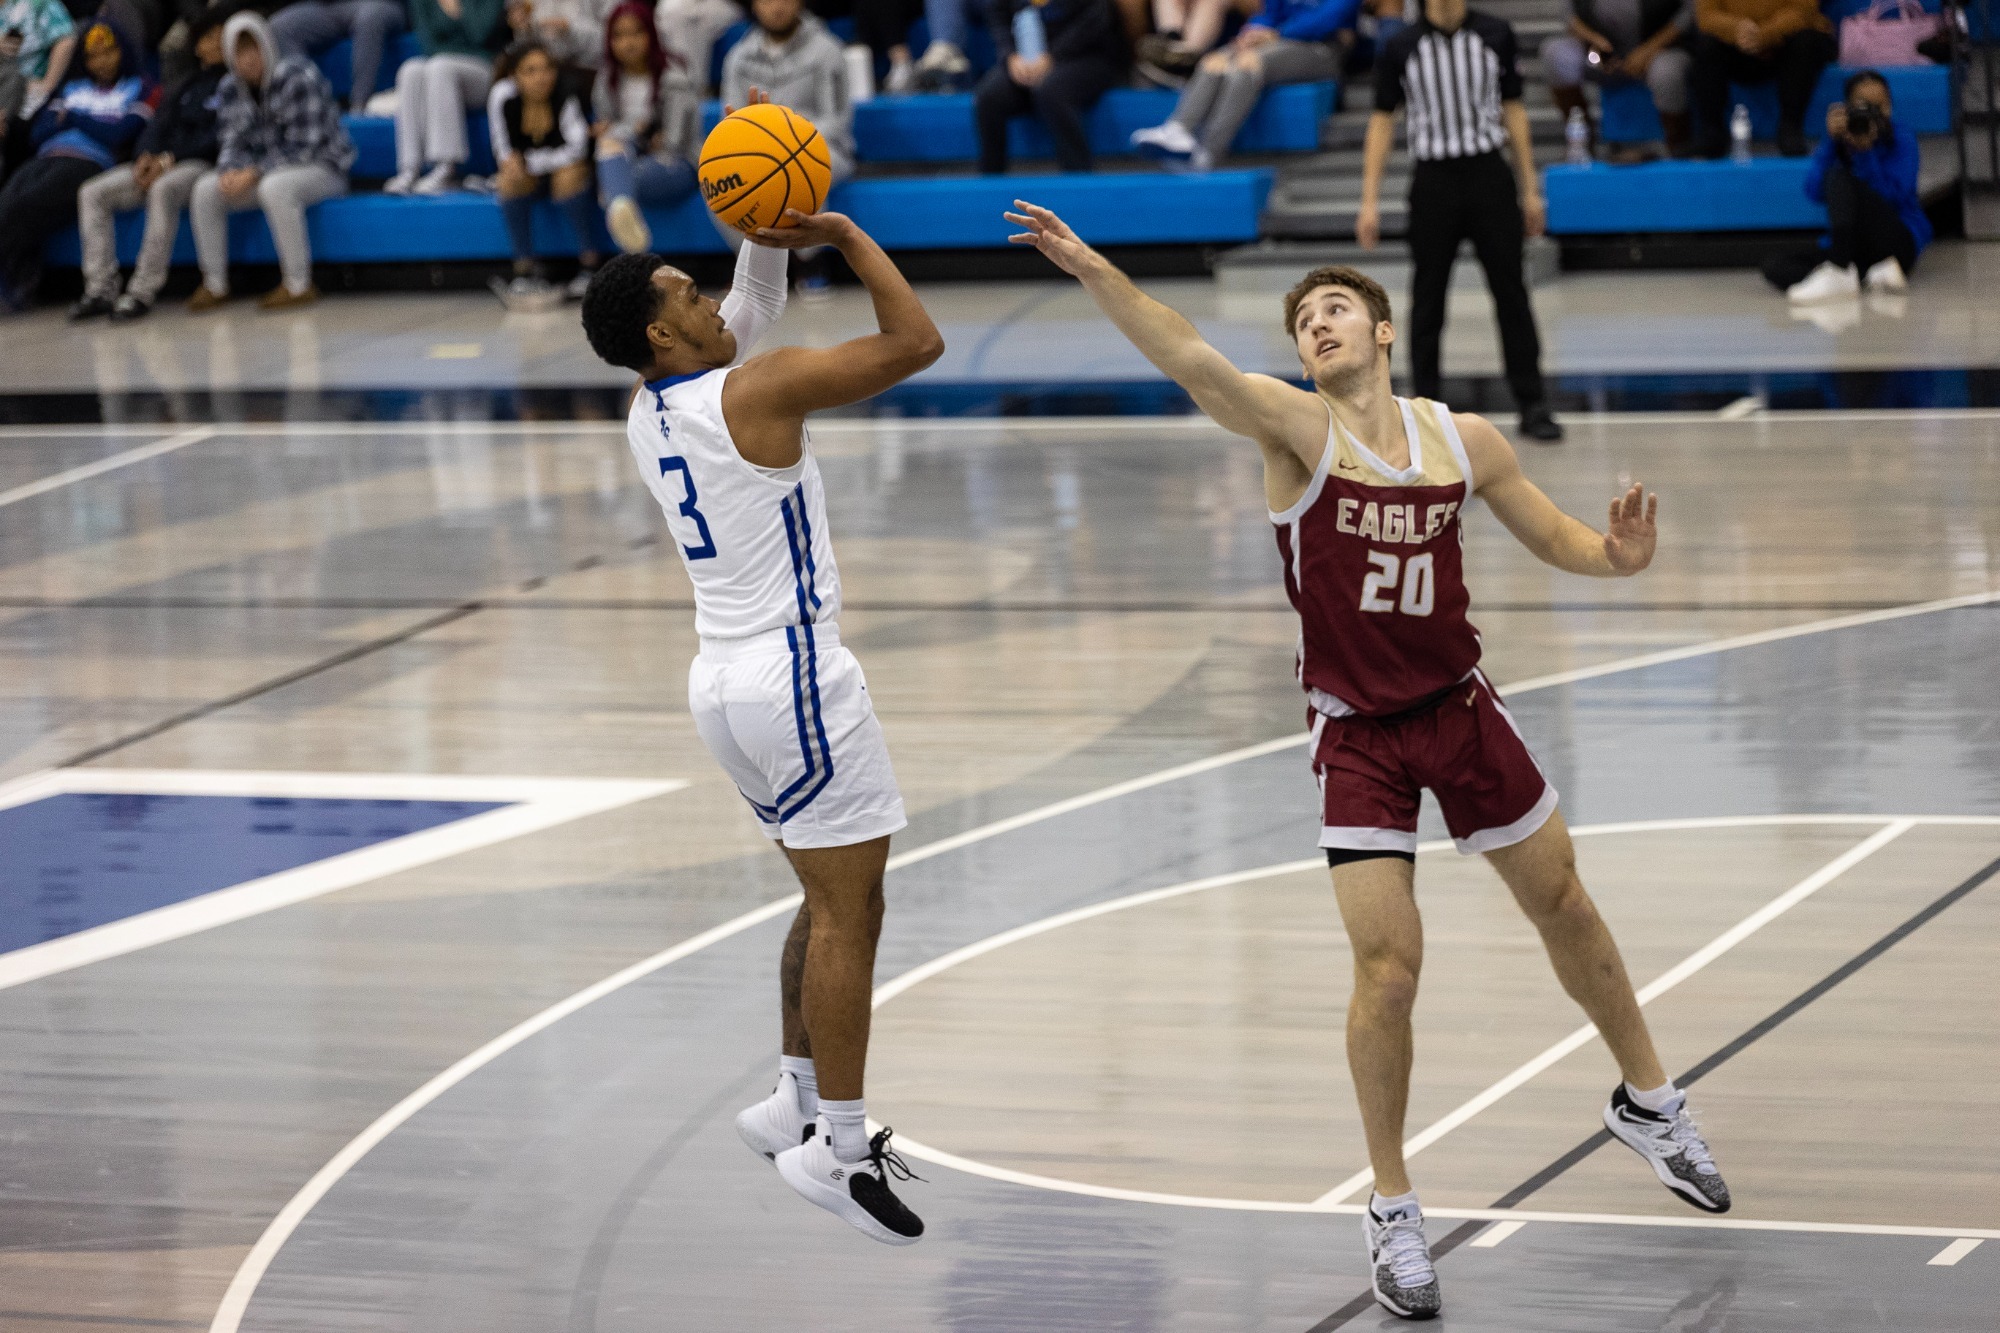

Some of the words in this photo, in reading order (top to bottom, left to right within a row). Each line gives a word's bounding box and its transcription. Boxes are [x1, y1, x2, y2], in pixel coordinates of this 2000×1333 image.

[702, 173, 744, 200] lson
[658, 455, 717, 561] 3
[1359, 548, 1435, 617] 20
